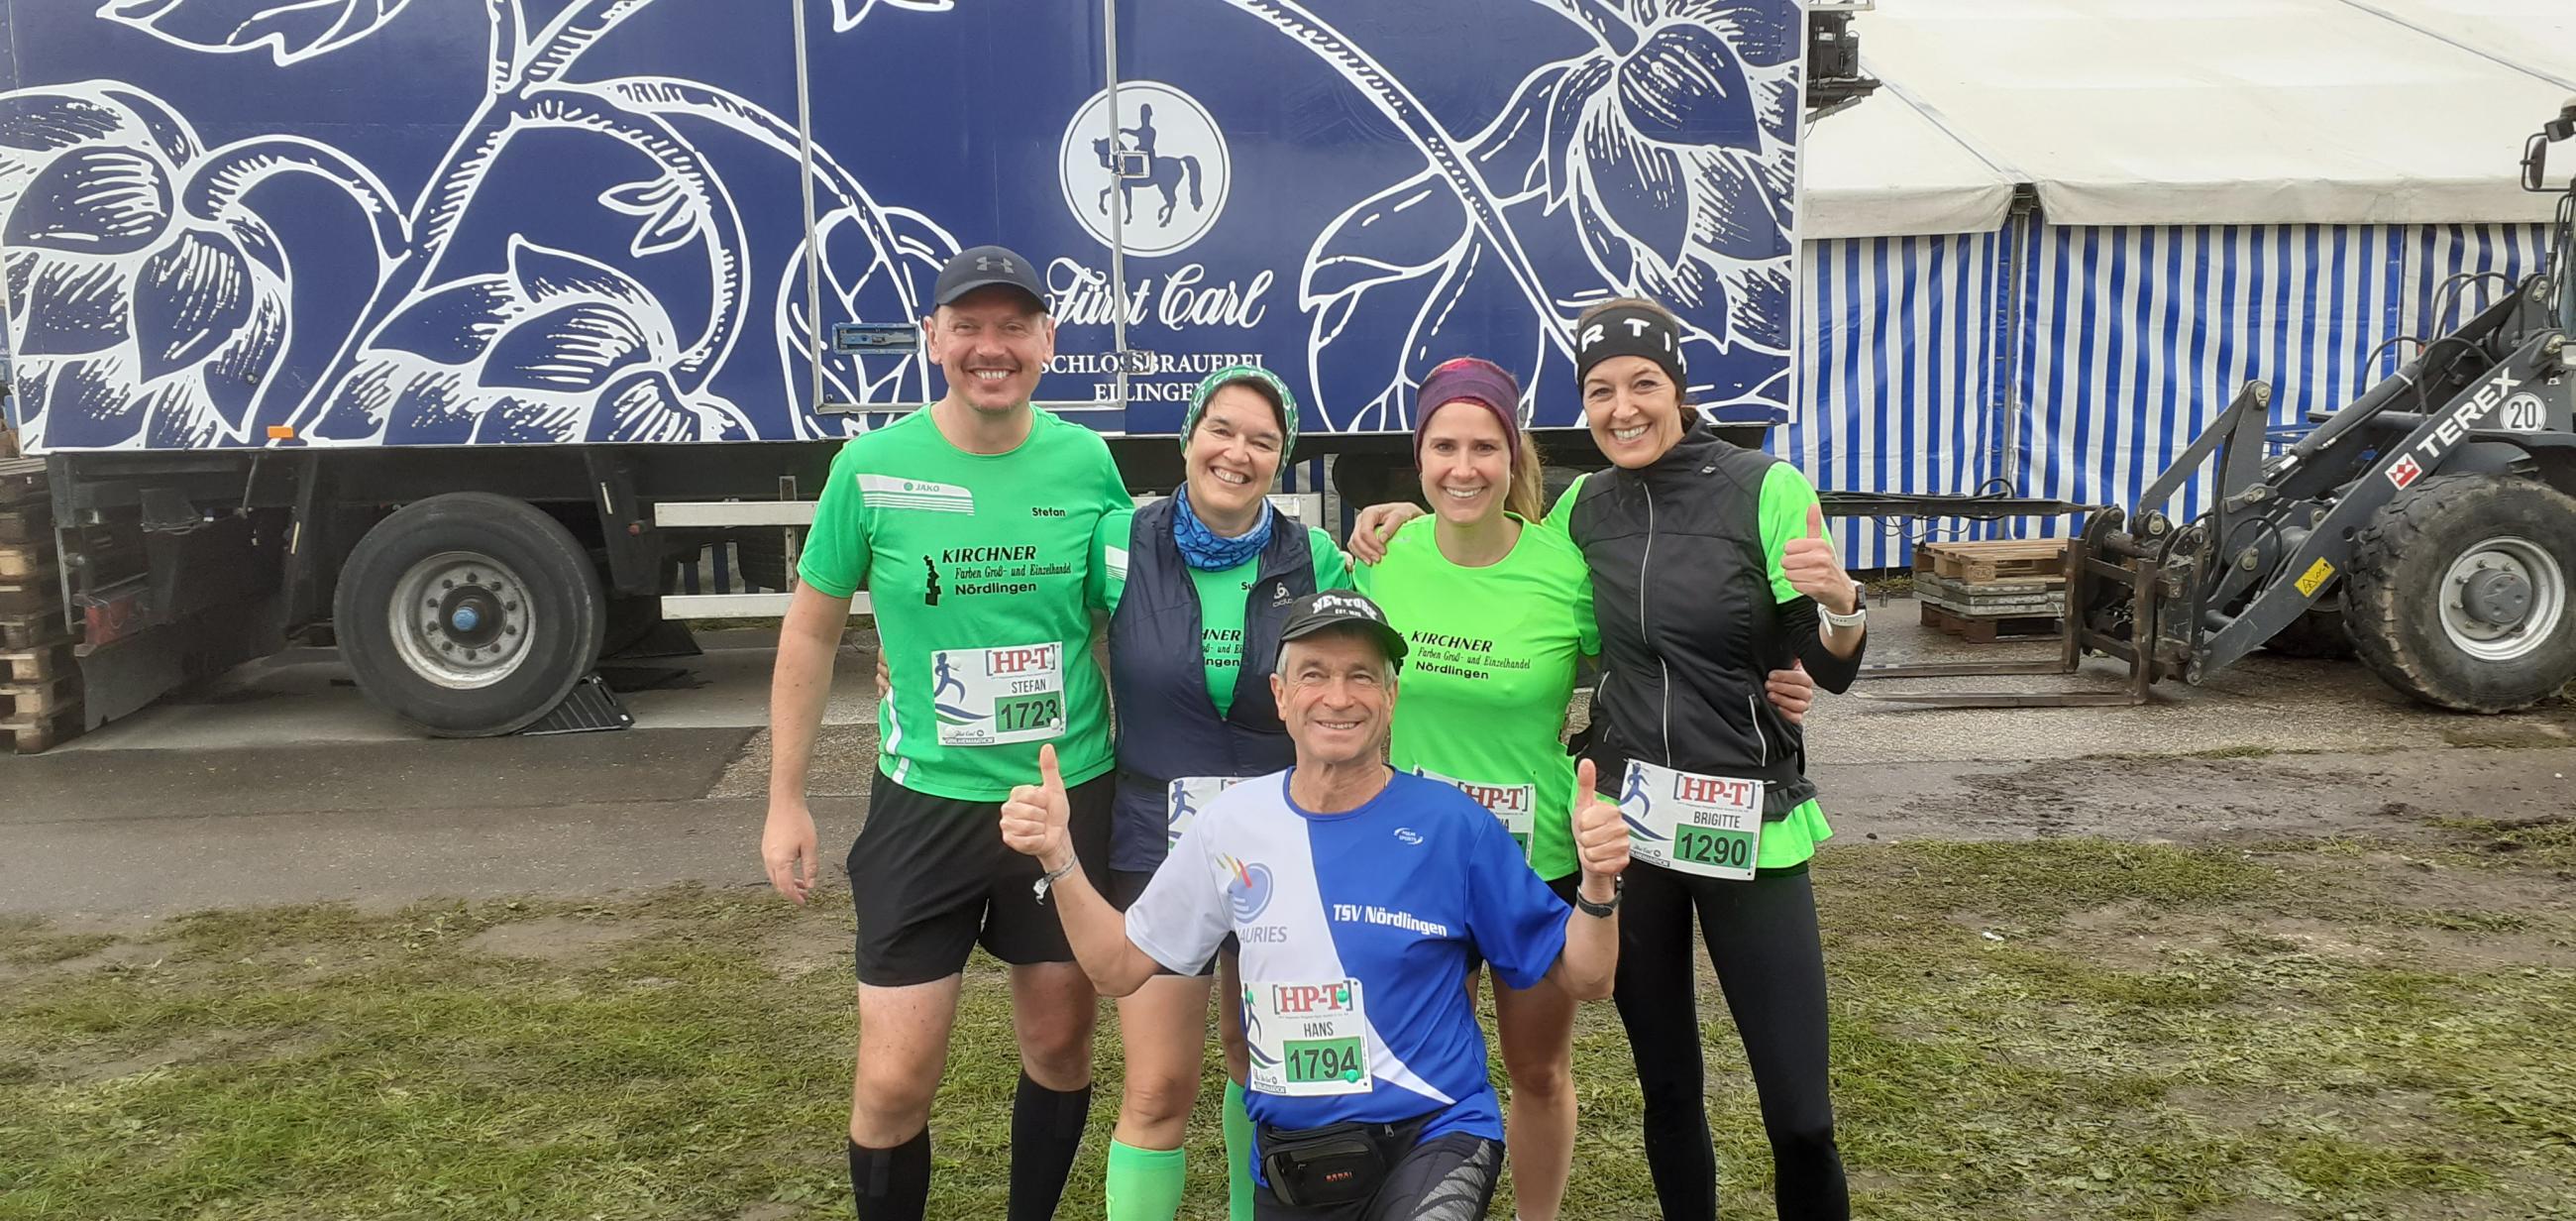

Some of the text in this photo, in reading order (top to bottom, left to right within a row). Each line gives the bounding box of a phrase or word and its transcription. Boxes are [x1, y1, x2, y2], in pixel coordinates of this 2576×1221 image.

[1159, 264, 1274, 331] Carl
[1093, 383, 1201, 402] ELLINGE
[2415, 366, 2522, 459] TEREX
[2510, 400, 2536, 430] 20
[914, 483, 941, 493] JAKO
[1031, 506, 1066, 517] Stefan
[942, 545, 1037, 564] KIRCHNER
[954, 566, 982, 580] Farben
[1011, 564, 1026, 577] und
[1029, 562, 1072, 576] Einzelhandel
[954, 582, 1037, 596] Nördlingen
[1217, 643, 1232, 653] und
[1411, 630, 1493, 652] KIRCHNER
[1418, 646, 1442, 659] Farben
[1467, 654, 1481, 665] und
[1483, 655, 1531, 669] Einzelhandel
[1415, 661, 1489, 679] Nördlingen
[1011, 679, 1046, 694] STEFAN
[1001, 699, 1058, 729] 1723
[1693, 811, 1741, 829] BRIGITTE
[1681, 832, 1747, 866] 1290
[1334, 904, 1448, 937] TSV Nördlingen
[1304, 1022, 1334, 1038] HANS
[1290, 1046, 1358, 1080] 1794
